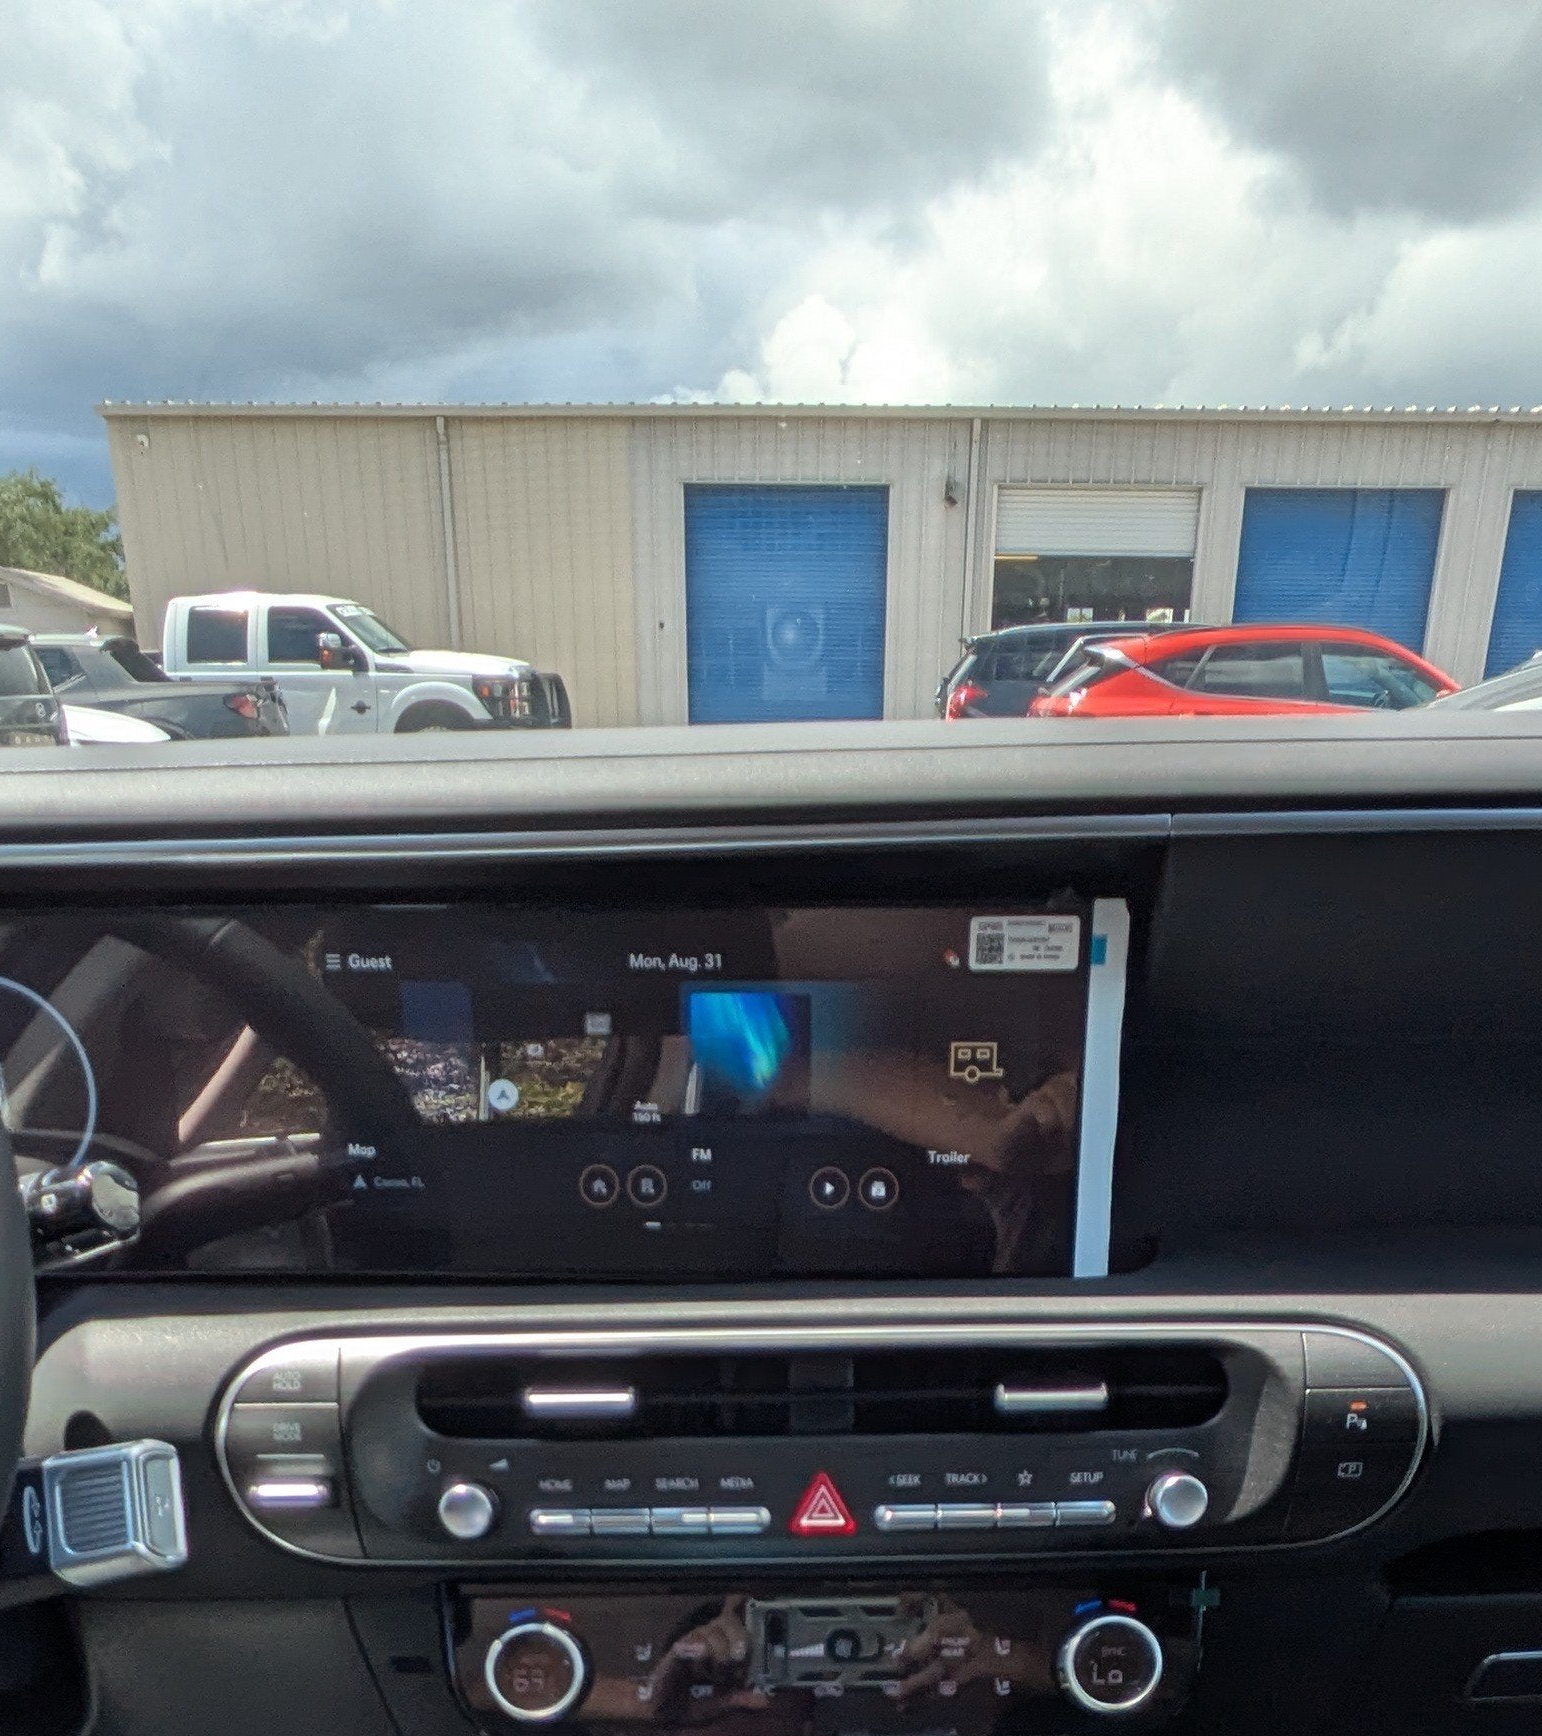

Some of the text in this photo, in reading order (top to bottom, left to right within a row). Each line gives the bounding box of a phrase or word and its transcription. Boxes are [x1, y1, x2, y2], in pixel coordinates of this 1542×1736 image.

[347, 953, 393, 970] Guest
[668, 953, 702, 973] Aug.
[704, 953, 722, 969] 31
[348, 1143, 377, 1158] Map
[691, 1147, 712, 1161] FM
[928, 1150, 971, 1164] Trailer
[1069, 1471, 1104, 1484] SETUP
